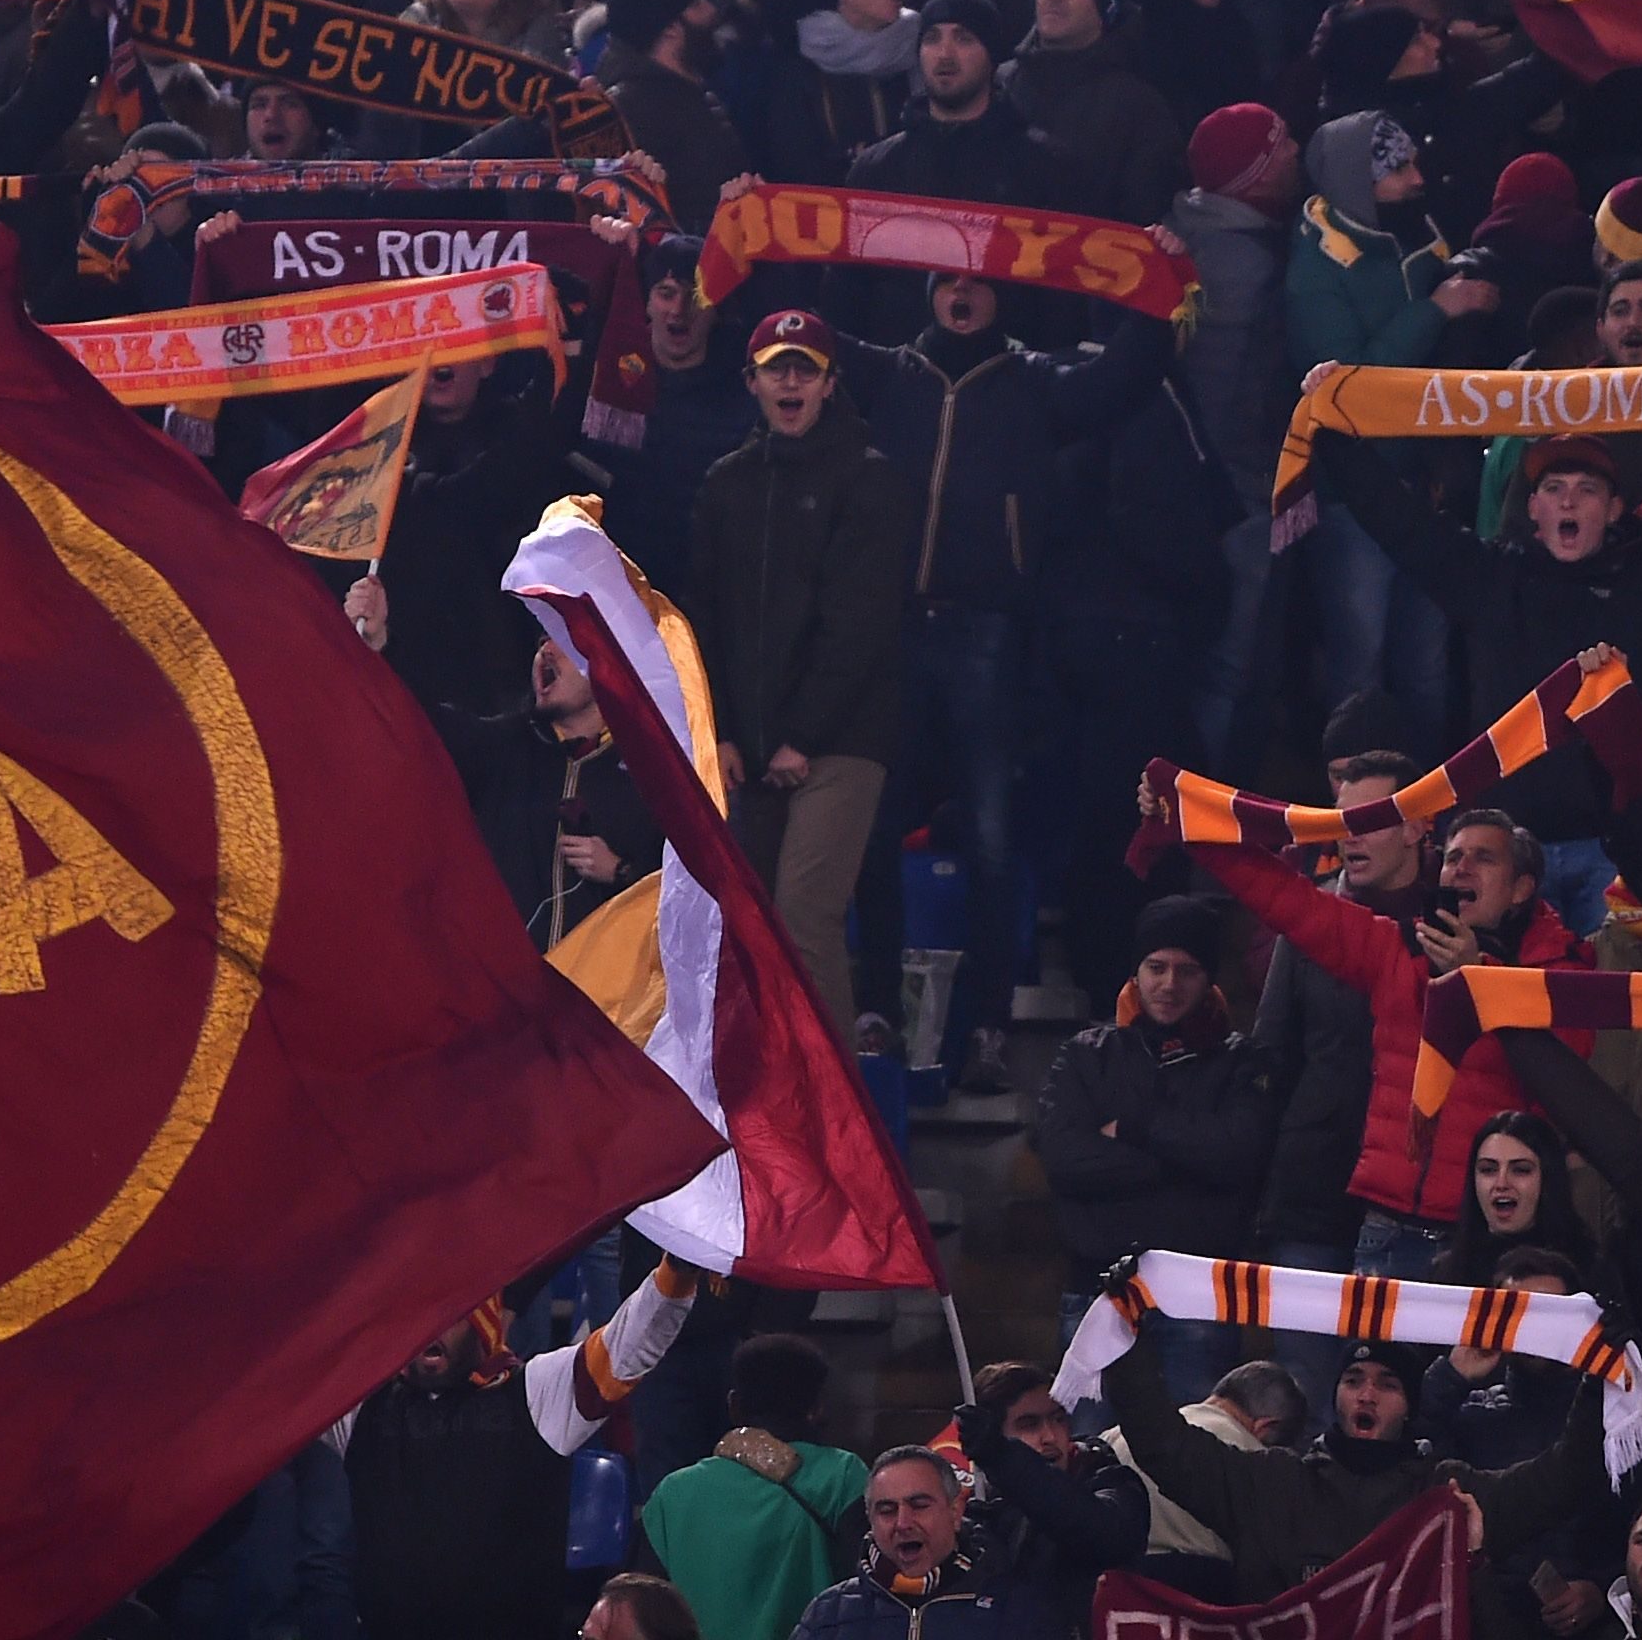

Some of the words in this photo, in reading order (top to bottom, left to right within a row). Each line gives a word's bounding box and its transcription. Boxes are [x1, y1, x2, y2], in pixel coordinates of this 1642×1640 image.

[308, 17, 395, 93] SE
[272, 230, 346, 280] AS
[79, 331, 203, 378] RZA
[287, 294, 461, 356] ROMA
[1415, 373, 1492, 427] AS
